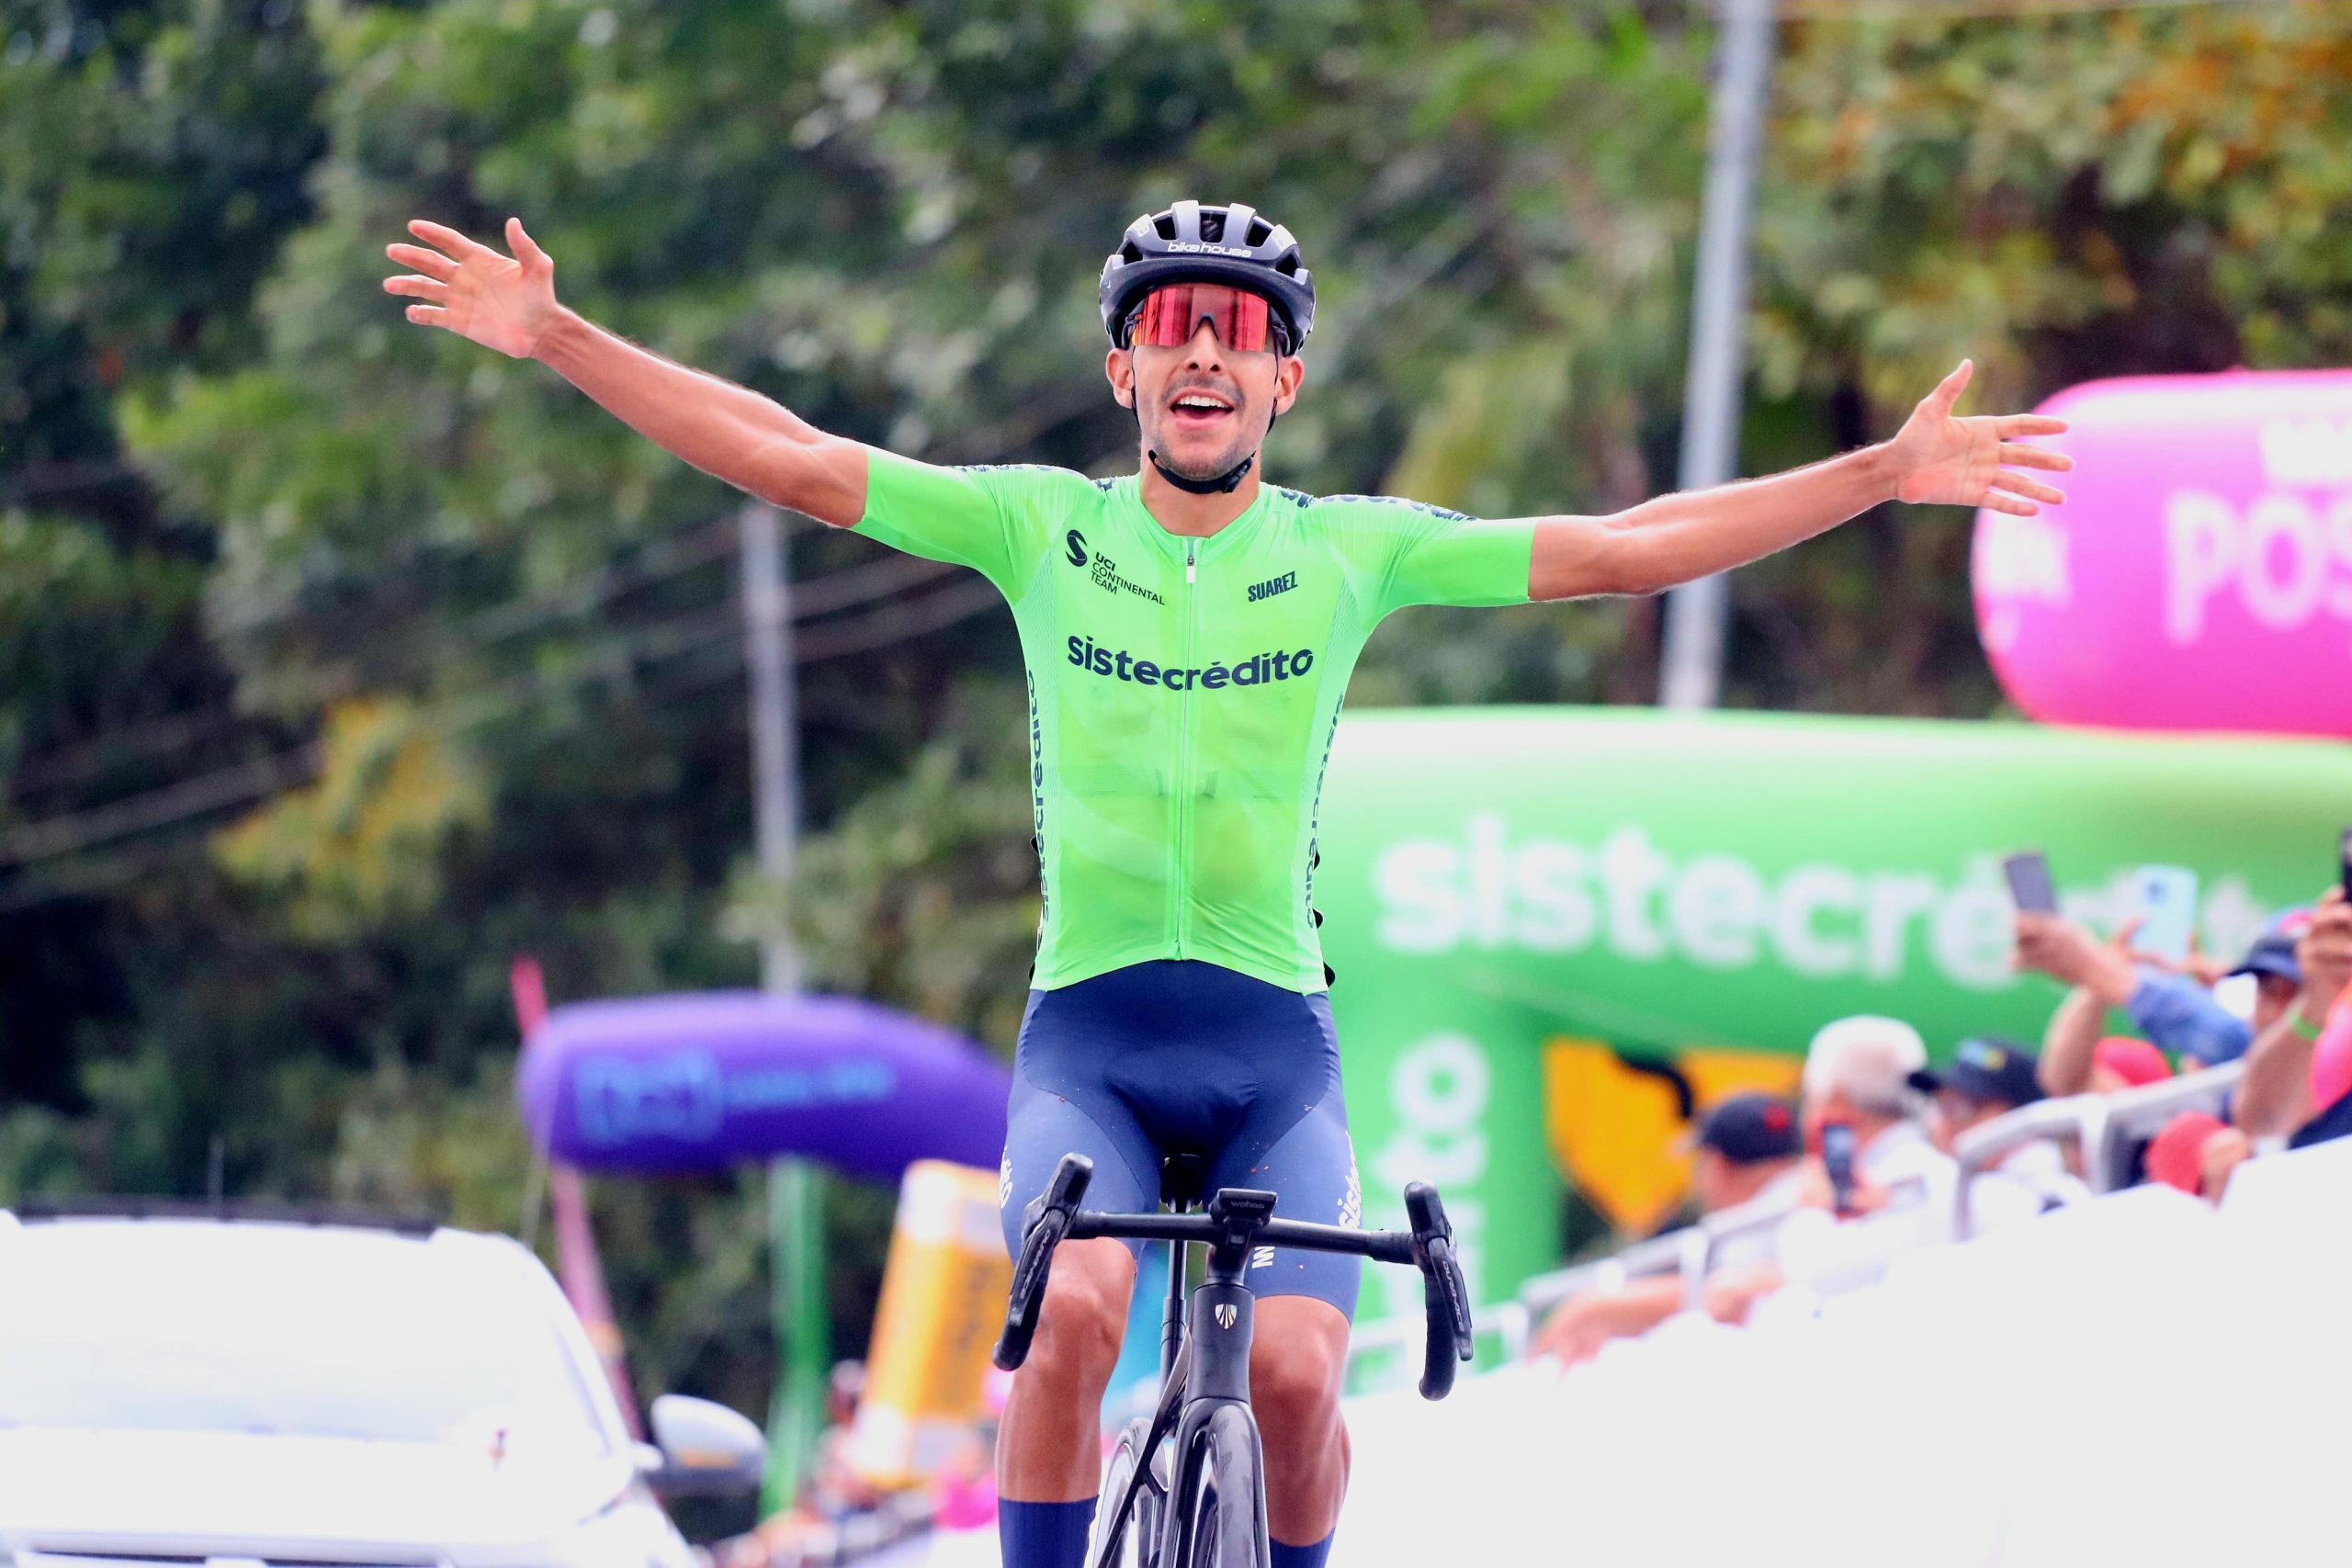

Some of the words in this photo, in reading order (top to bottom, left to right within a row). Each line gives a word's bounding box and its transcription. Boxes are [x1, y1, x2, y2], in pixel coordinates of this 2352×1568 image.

[1095, 551, 1116, 571] UCI
[1091, 570, 1118, 595] TEAM
[1092, 561, 1166, 606] CONTINENTAL
[1248, 570, 1298, 603] SUAREZ
[1068, 635, 1314, 691] sistecrédito
